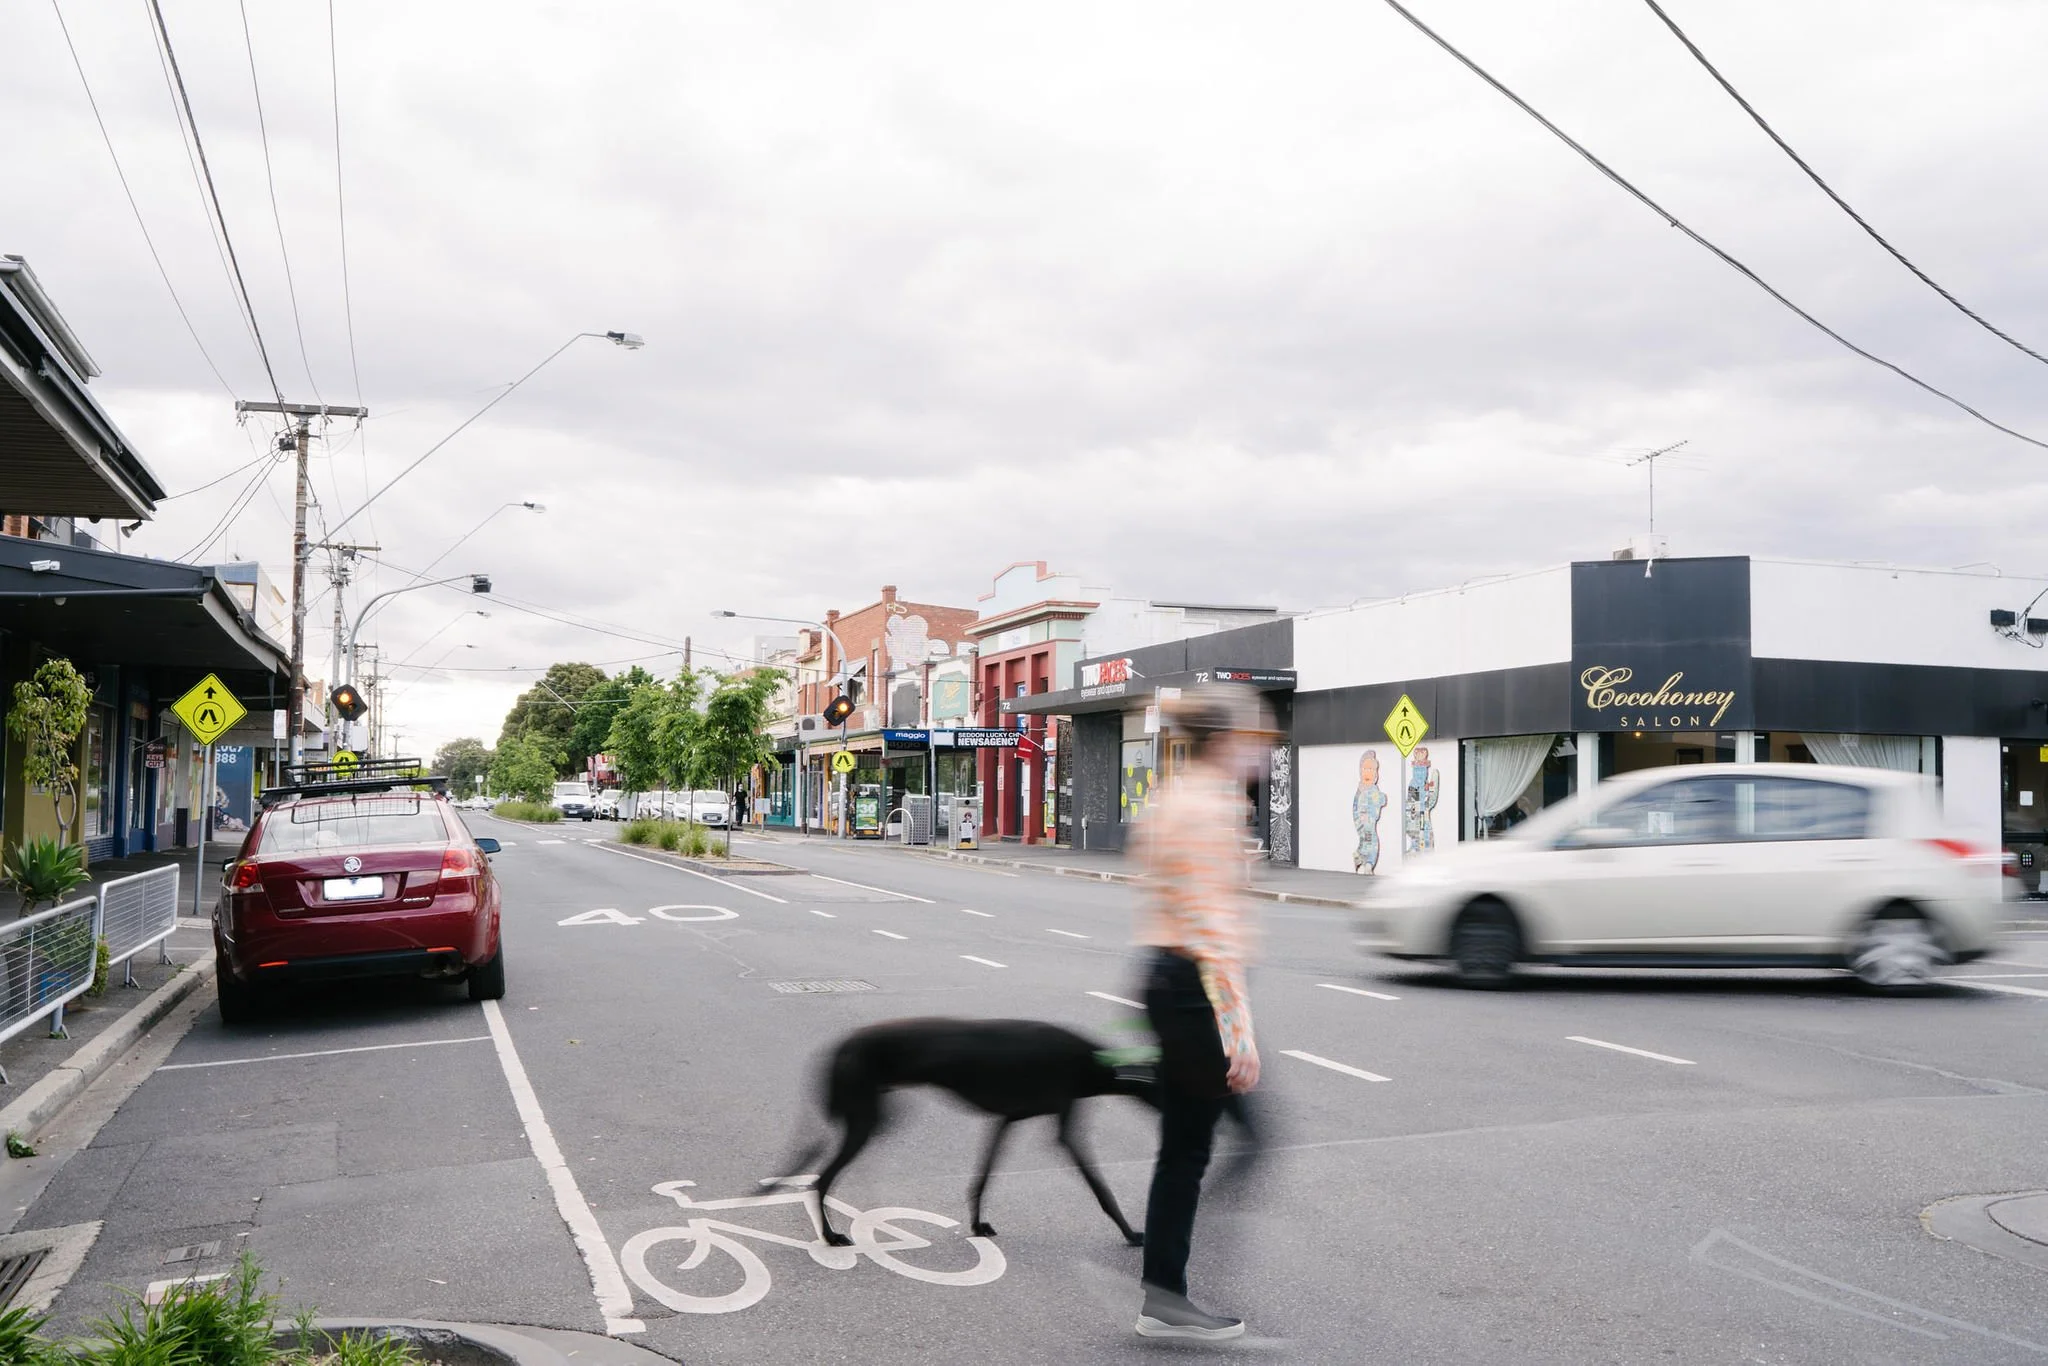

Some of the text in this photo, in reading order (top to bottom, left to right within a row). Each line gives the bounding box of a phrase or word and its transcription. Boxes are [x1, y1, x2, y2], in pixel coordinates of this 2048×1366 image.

[1195, 672, 1208, 683] 72
[1581, 665, 1735, 727] Cocohoney
[1002, 702, 1010, 710] 72
[1620, 716, 1699, 727] SALON
[958, 738, 1019, 746] NEWSAGENCY
[556, 904, 740, 926] 40
